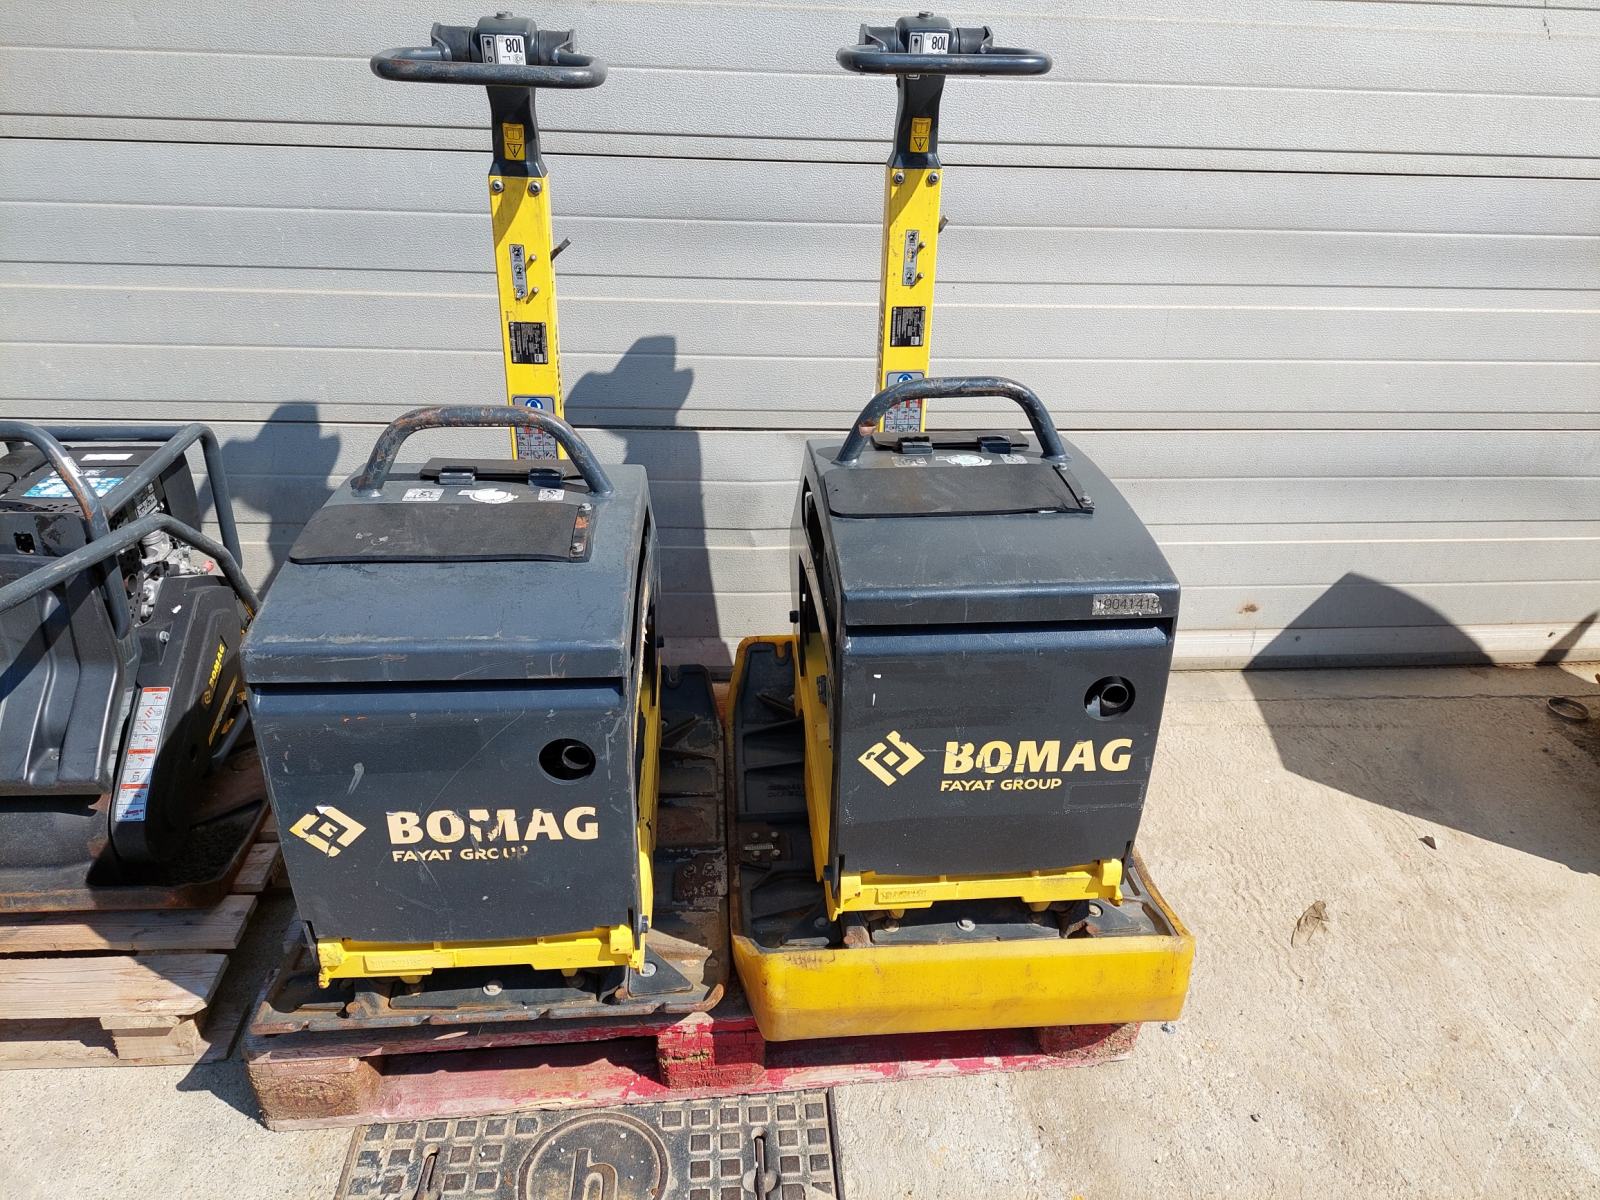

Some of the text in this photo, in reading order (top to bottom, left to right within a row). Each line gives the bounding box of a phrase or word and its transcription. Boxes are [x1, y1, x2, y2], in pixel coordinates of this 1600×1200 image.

[942, 739, 1133, 775] BOMAG
[940, 778, 1062, 791] FAYAT GROUP
[386, 806, 598, 844] BOMAG
[392, 850, 452, 862] FAYAT
